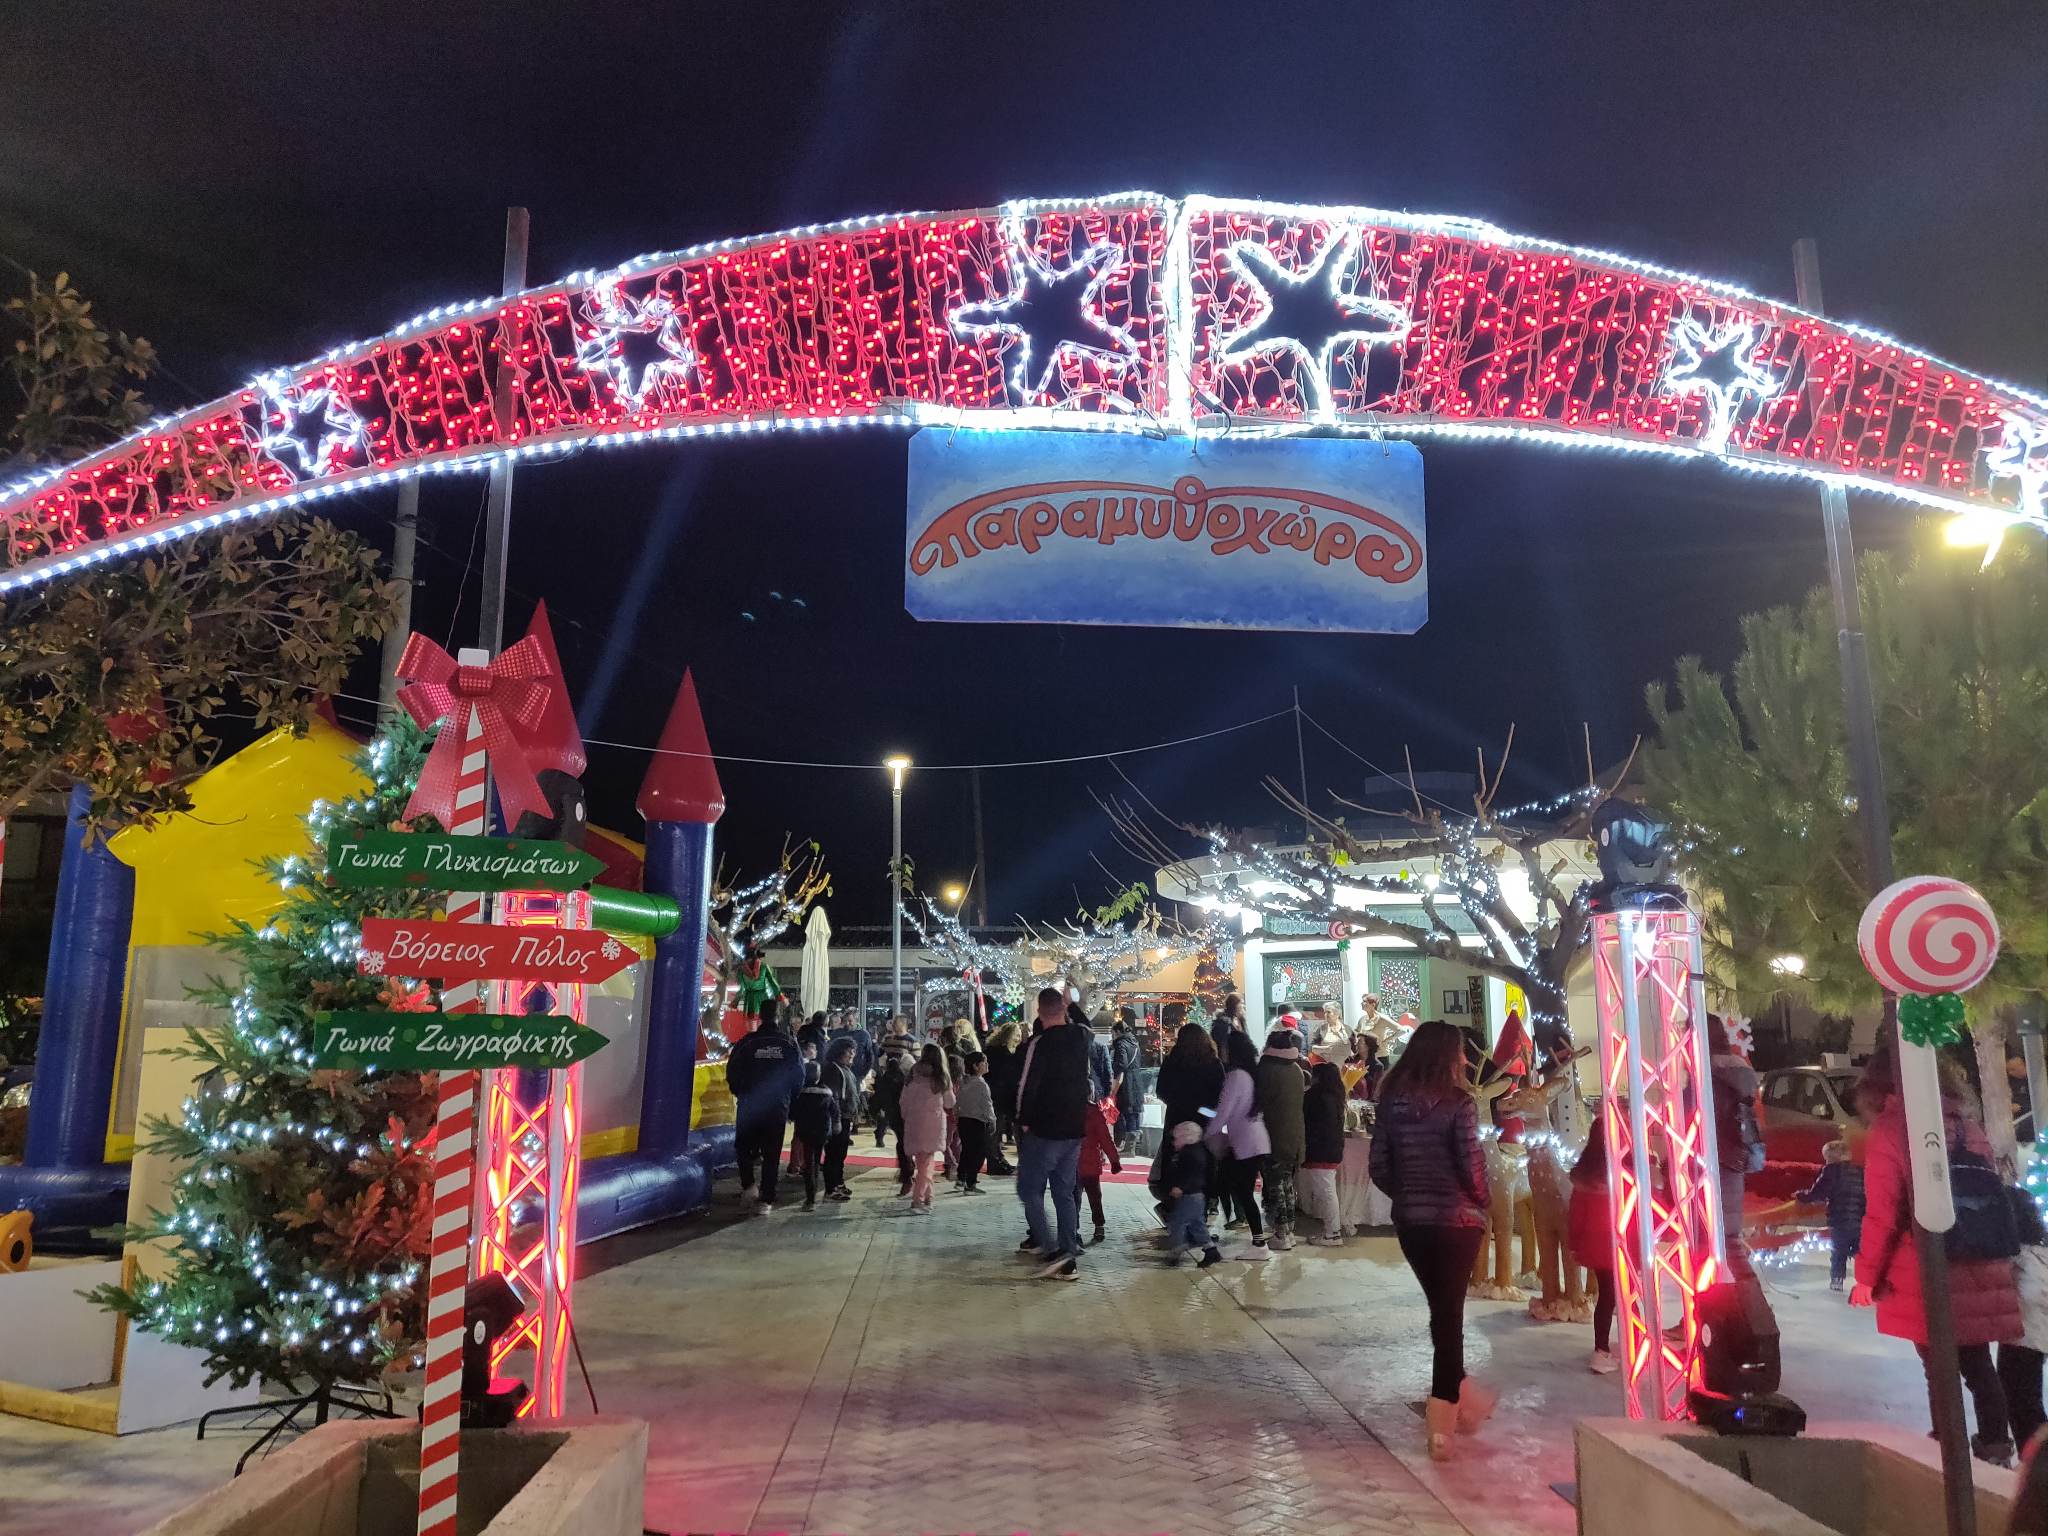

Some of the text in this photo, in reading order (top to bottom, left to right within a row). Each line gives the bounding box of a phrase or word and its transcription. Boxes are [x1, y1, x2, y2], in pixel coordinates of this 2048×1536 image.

[909, 475, 1424, 583] Παραμυθοχώρα
[338, 844, 580, 876] Γωνιά Γλυκισμάτων
[388, 930, 597, 973] Βόρειος Πόλος
[324, 1024, 579, 1062] Γωνιά Ζωγραφικής
